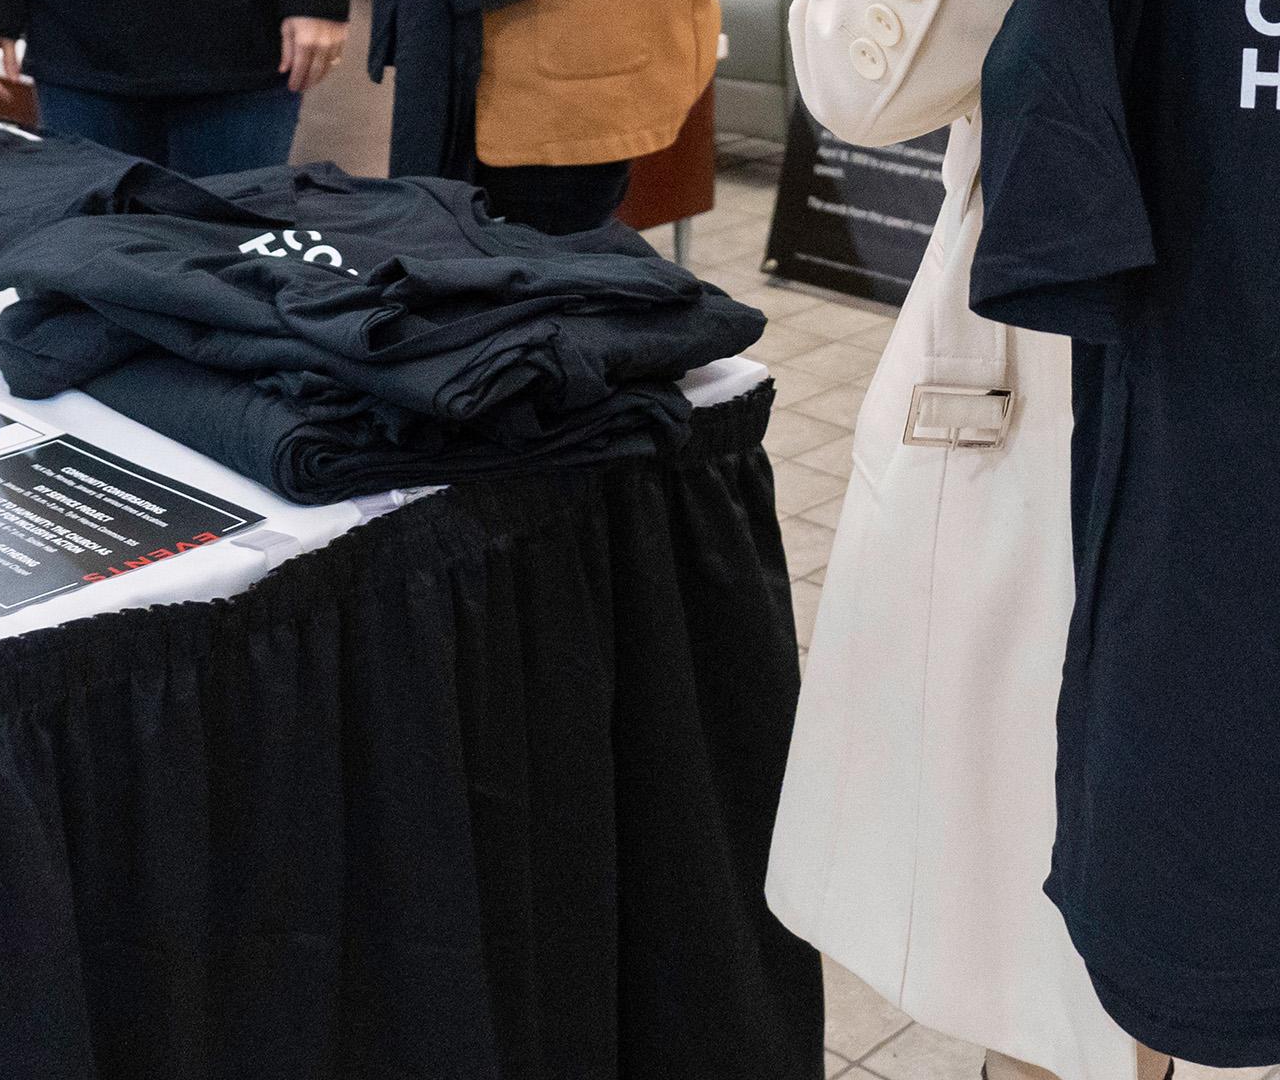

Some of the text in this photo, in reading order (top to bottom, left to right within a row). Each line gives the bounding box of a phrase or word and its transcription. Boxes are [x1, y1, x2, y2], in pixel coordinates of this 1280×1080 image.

[43, 490, 83, 507] SERVICE
[73, 504, 115, 522] PROJECT
[58, 466, 167, 514] COMMUNITY CONVERSATIONS
[82, 531, 221, 583] EVENTS
